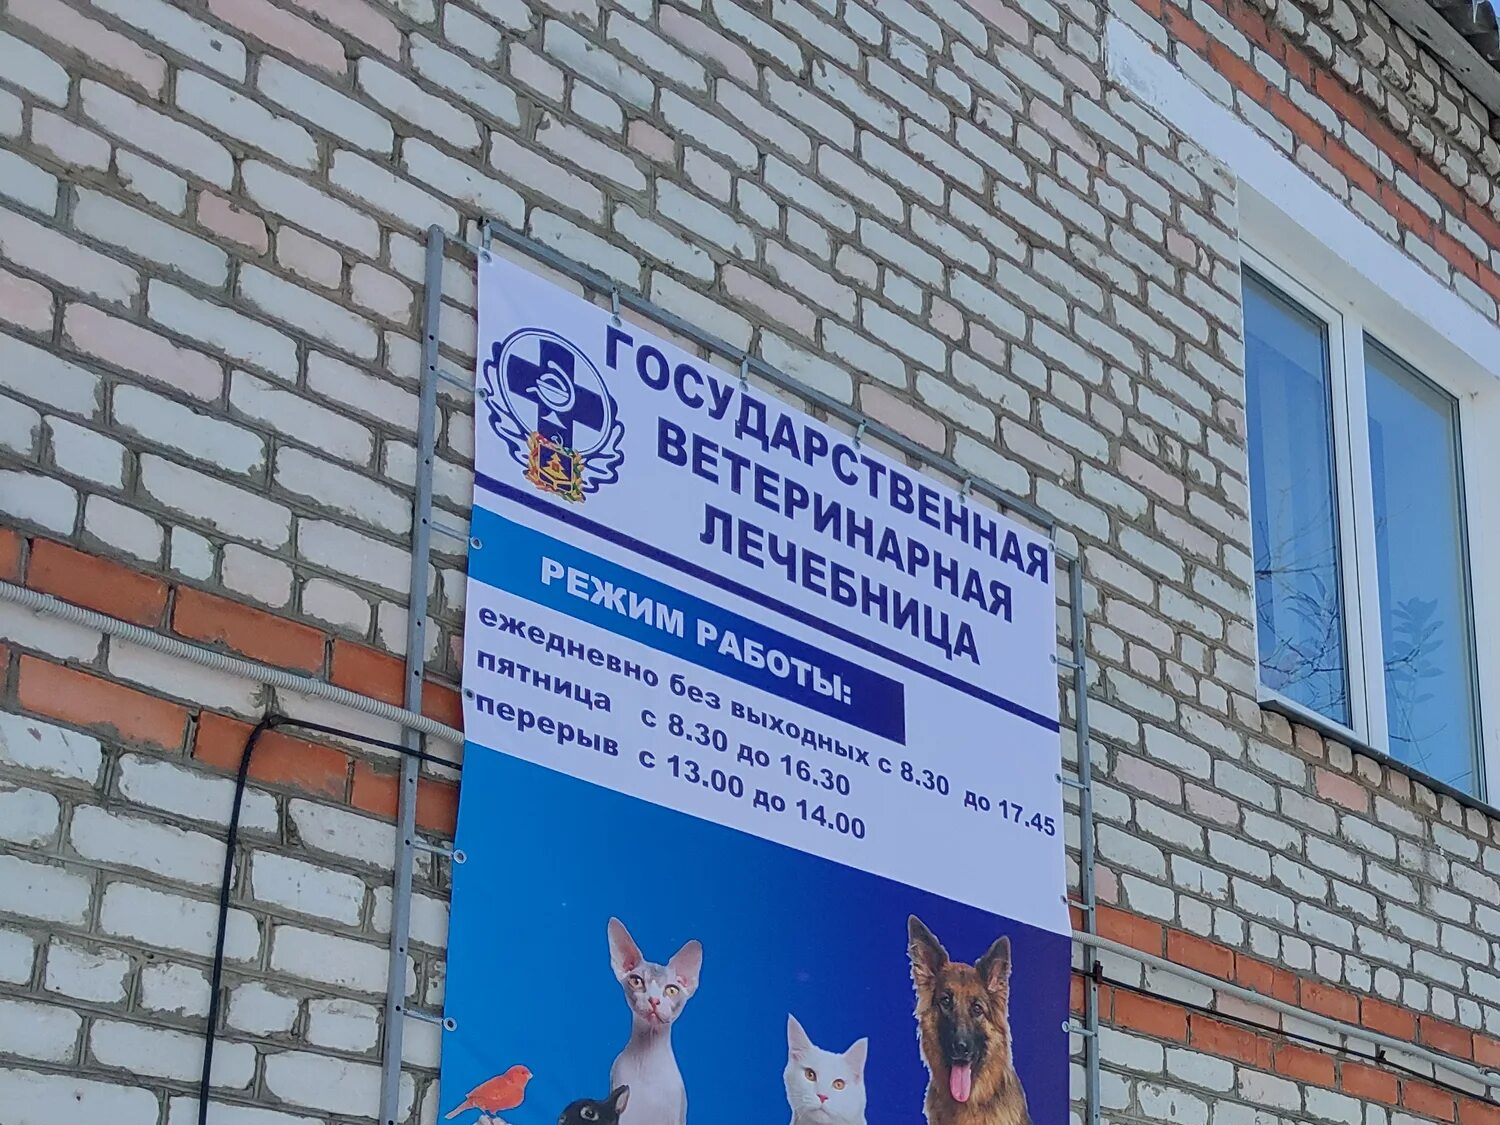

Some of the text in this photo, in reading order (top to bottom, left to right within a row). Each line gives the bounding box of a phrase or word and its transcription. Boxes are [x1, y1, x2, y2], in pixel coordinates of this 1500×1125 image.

[606, 325, 1048, 584] ГОСУДАРСТВЕННАЯ
[658, 417, 1013, 623] ВЕТЕРИНАРНАЯ
[541, 557, 852, 704] РЕЖИМ РАБОТЫ:
[700, 504, 980, 665] ЛЕЧЕБНИЦА
[476, 650, 850, 797] пятница с 8.30 до 16.30
[476, 693, 865, 840] перерыв с 13.00 до 14.00
[477, 607, 1055, 837] ежедневно без выходных с 8.30 до 17.45
